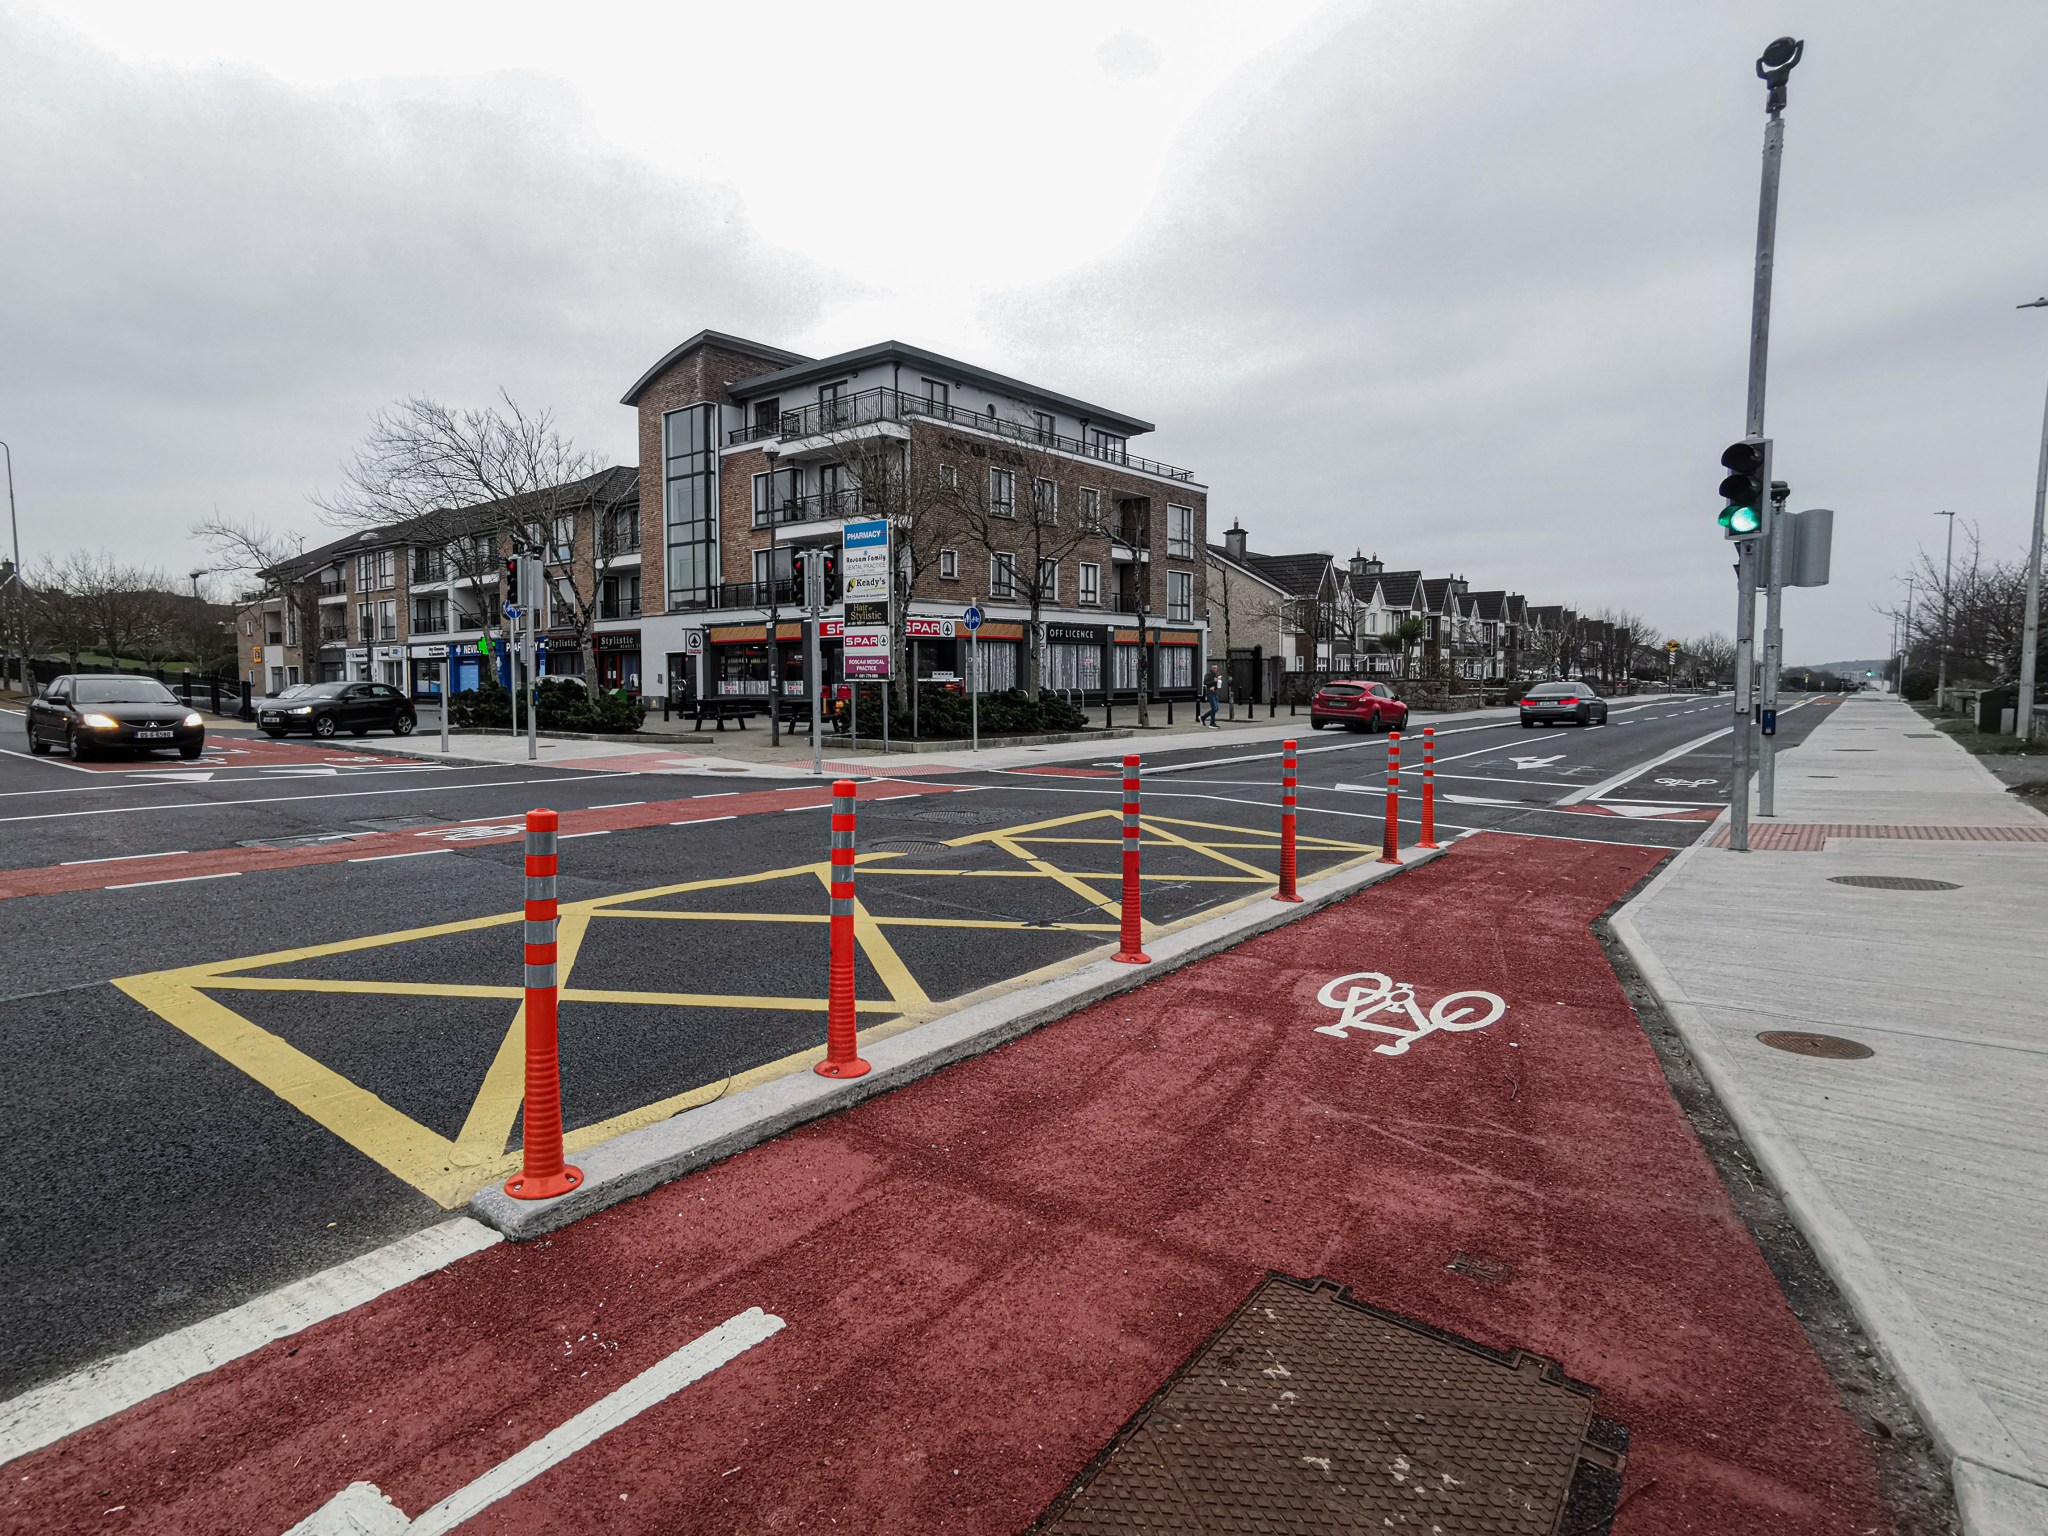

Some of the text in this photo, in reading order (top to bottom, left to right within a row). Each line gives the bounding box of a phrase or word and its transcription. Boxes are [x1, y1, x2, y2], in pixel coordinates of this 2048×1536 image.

[847, 529, 881, 541] PHARMACY
[867, 554, 886, 562] Family
[856, 577, 886, 587] Keady's
[853, 603, 868, 612] Hair
[850, 610, 882, 621] Stylistic
[1049, 628, 1094, 639] OFF LICENCE
[549, 639, 577, 648] Stylistic
[601, 636, 634, 646] Stylistic
[846, 636, 878, 646] SPAR
